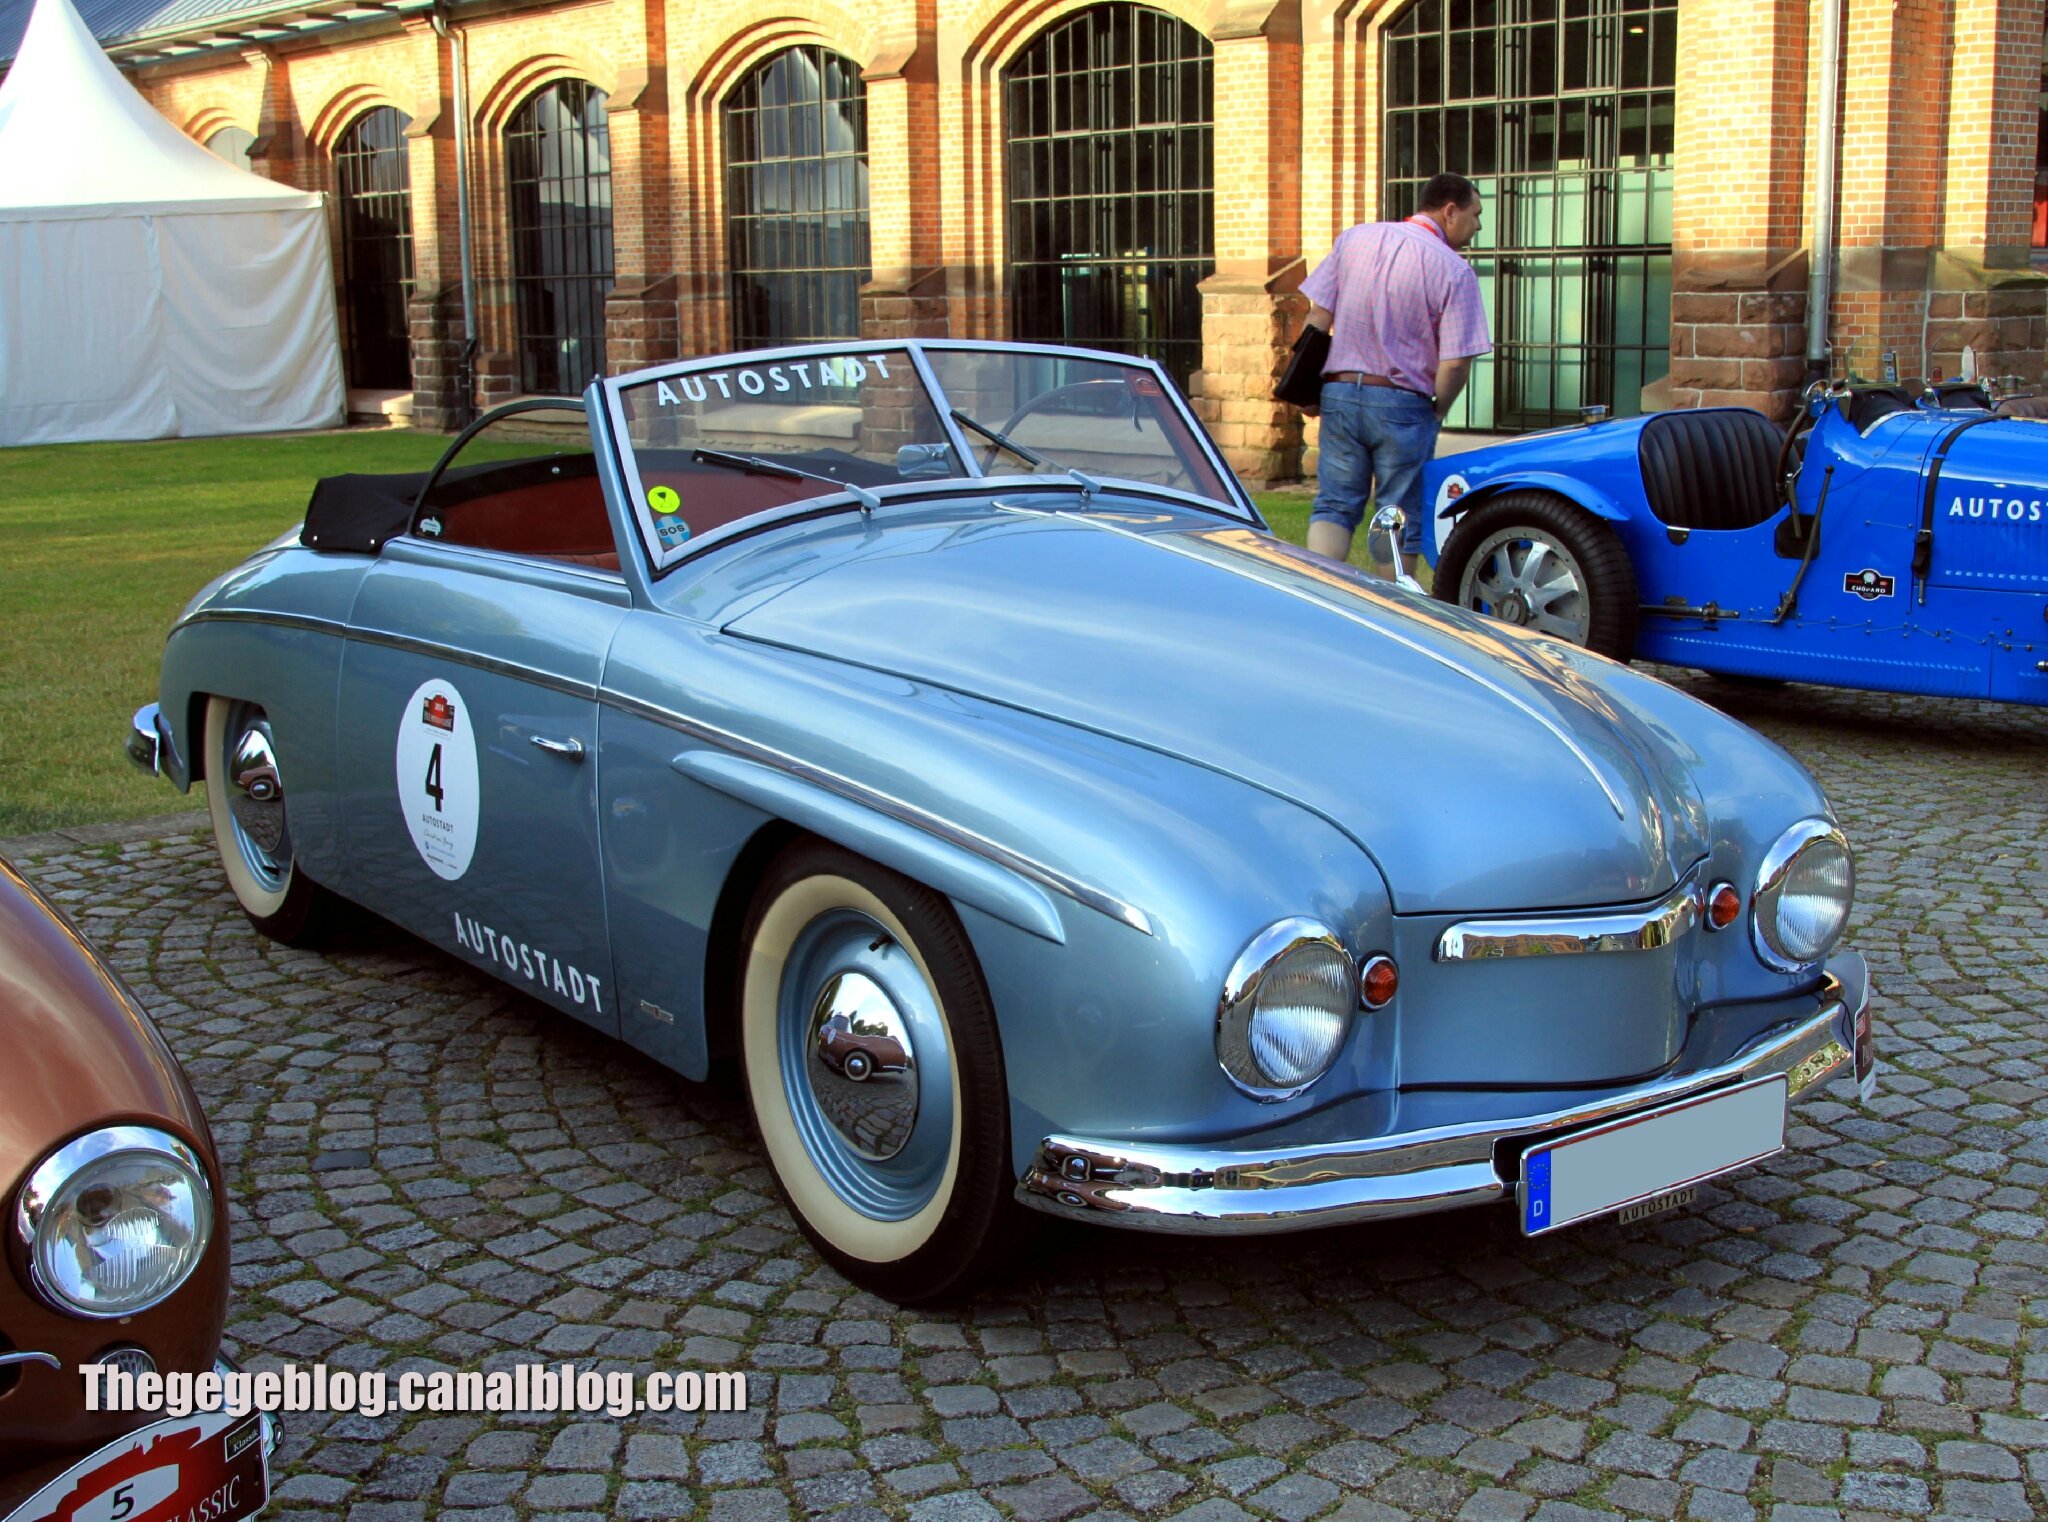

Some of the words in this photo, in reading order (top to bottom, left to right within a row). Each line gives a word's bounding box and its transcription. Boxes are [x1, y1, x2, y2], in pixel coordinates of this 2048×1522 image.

[657, 354, 890, 406] AUTOSTADT
[1949, 497, 2048, 521] AUTOS
[660, 524, 685, 537] SOS
[425, 743, 443, 812] 4
[422, 813, 454, 833] AUTOSTADT
[454, 912, 602, 1013] AUTOSTADT
[1533, 1200, 1543, 1217] D
[1623, 1189, 1695, 1222] AUTOSTADT
[111, 1483, 135, 1520] 5
[166, 1474, 240, 1522] ASSIC
